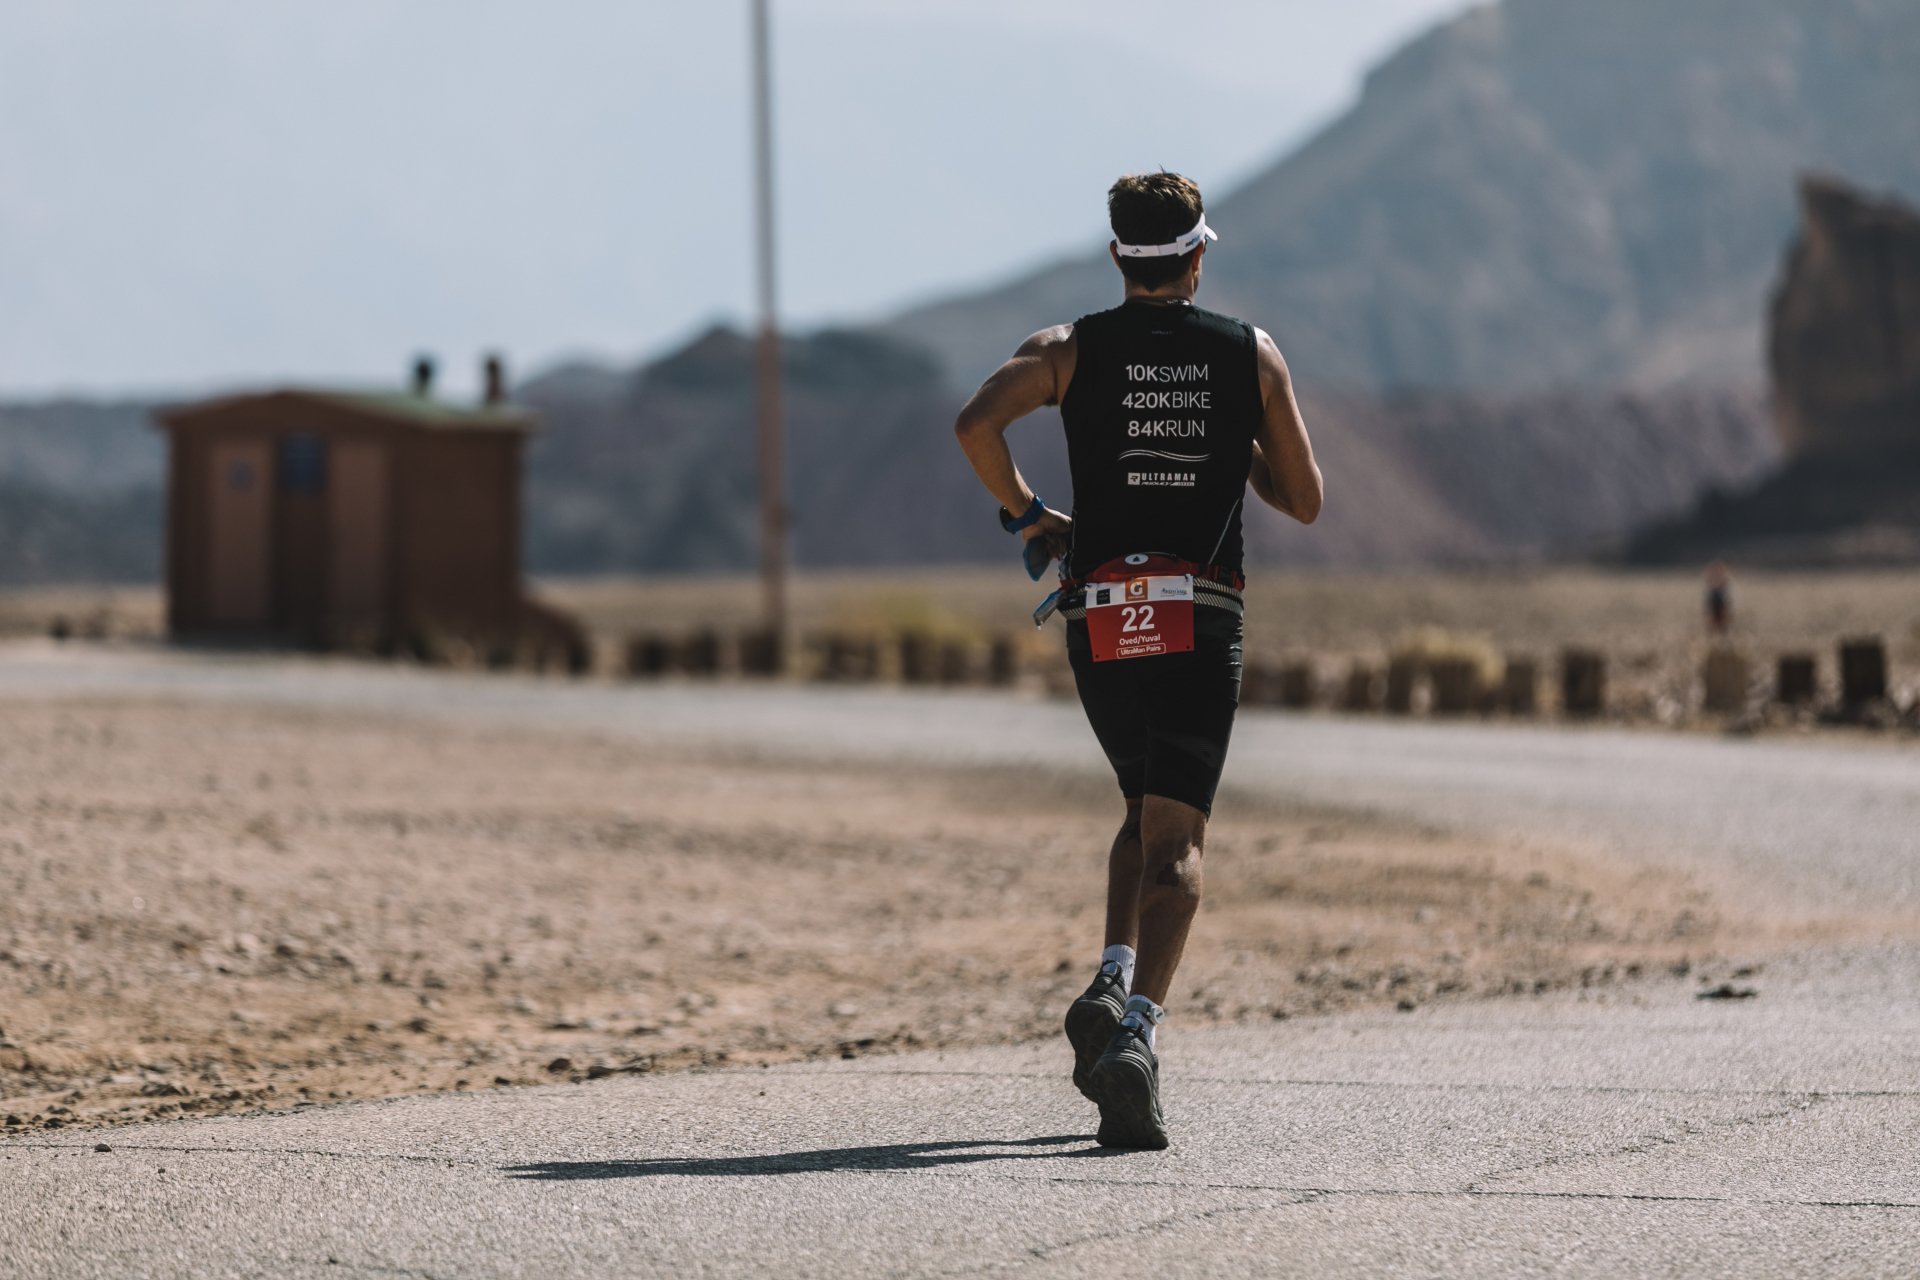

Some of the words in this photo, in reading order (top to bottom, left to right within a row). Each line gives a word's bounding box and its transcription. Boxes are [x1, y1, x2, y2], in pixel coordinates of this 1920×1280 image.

[1125, 364, 1209, 383] 10KSWIM
[1122, 391, 1212, 409] 420KBIKE
[1127, 419, 1206, 437] 84KRUN
[1141, 473, 1196, 481] ULTRAMAN
[1121, 605, 1155, 633] 22
[1119, 633, 1161, 646] Oved/Yuval
[1120, 647, 1146, 656] UltraMan
[1146, 645, 1162, 653] Pairs
